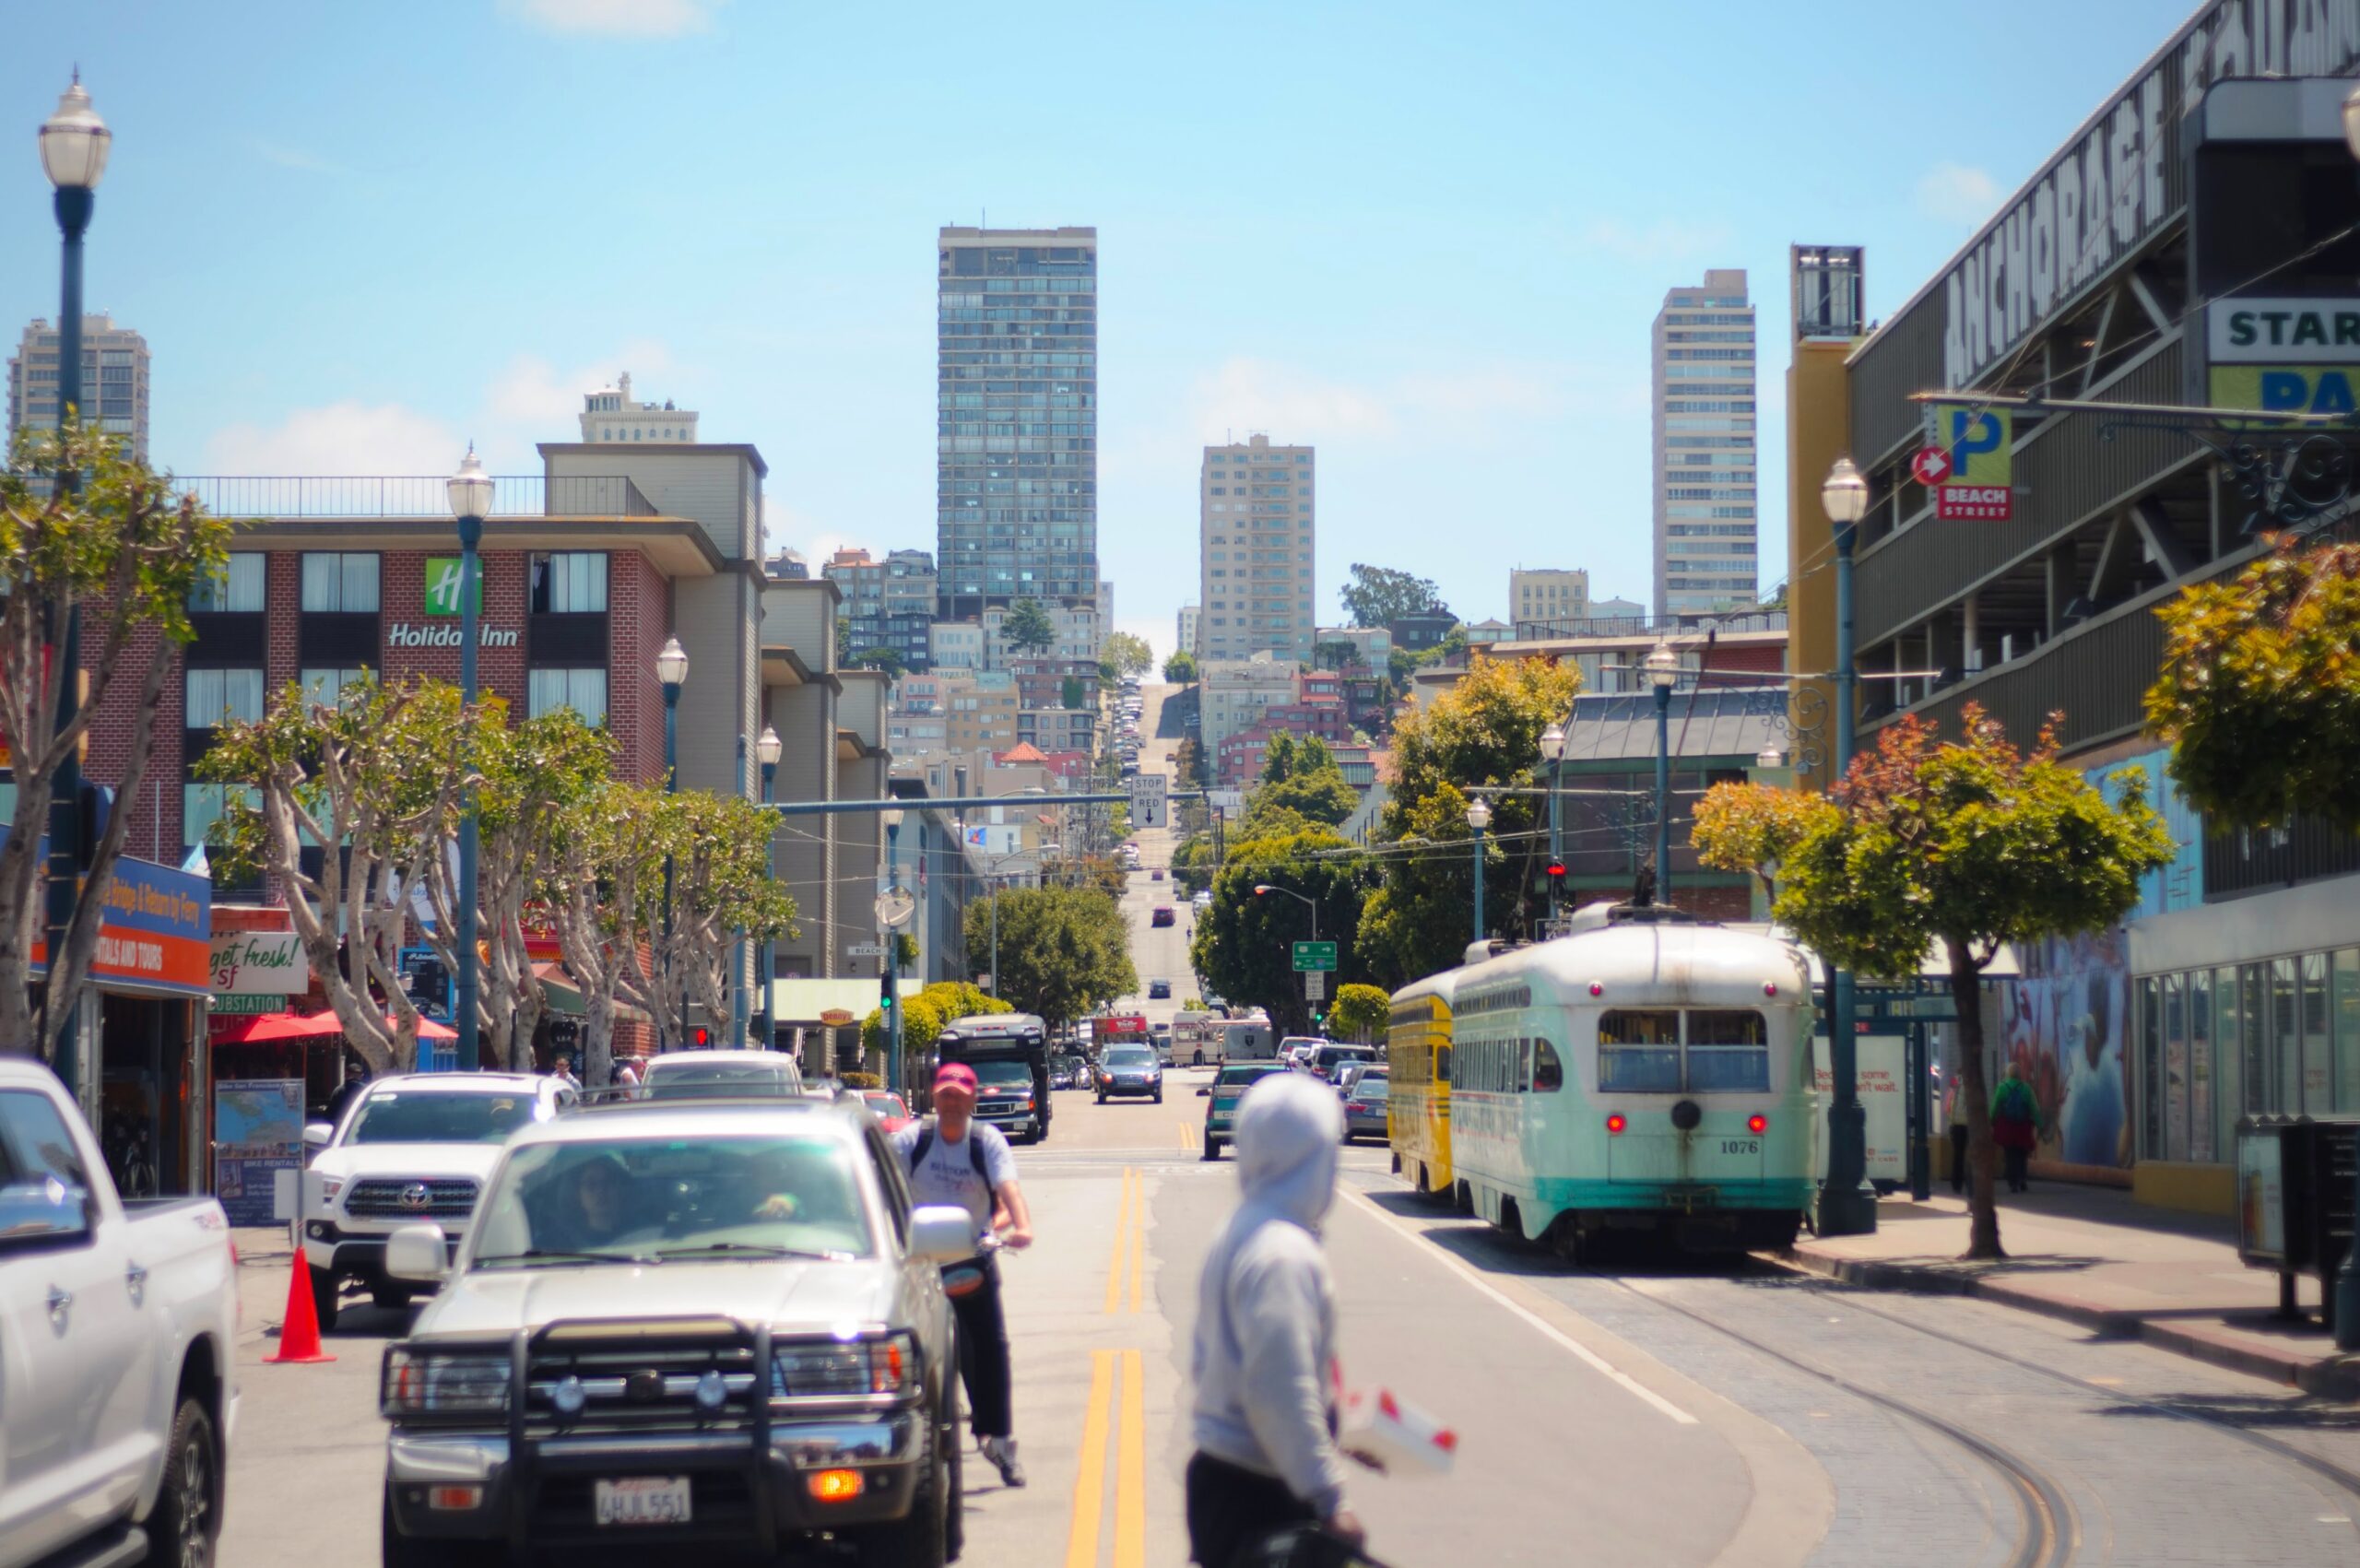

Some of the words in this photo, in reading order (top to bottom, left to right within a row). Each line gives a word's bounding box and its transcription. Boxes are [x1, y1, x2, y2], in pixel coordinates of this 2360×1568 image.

[2229, 311, 2360, 346] STAR
[1953, 411, 2001, 477] P
[1945, 489, 2007, 503] BEACH
[1945, 506, 2007, 516] STREET
[389, 623, 465, 646] Holida
[481, 623, 518, 646] Inn
[1136, 779, 1162, 788] STOP
[1139, 798, 1160, 808] RED
[95, 937, 120, 966] NTALS
[120, 939, 136, 968] AND
[137, 942, 163, 971] TOURS
[209, 942, 243, 976] get
[242, 937, 301, 968] fresh!
[1860, 1071, 1890, 1079] some
[1874, 1081, 1899, 1091] wait.
[1721, 1141, 1758, 1153] 1076
